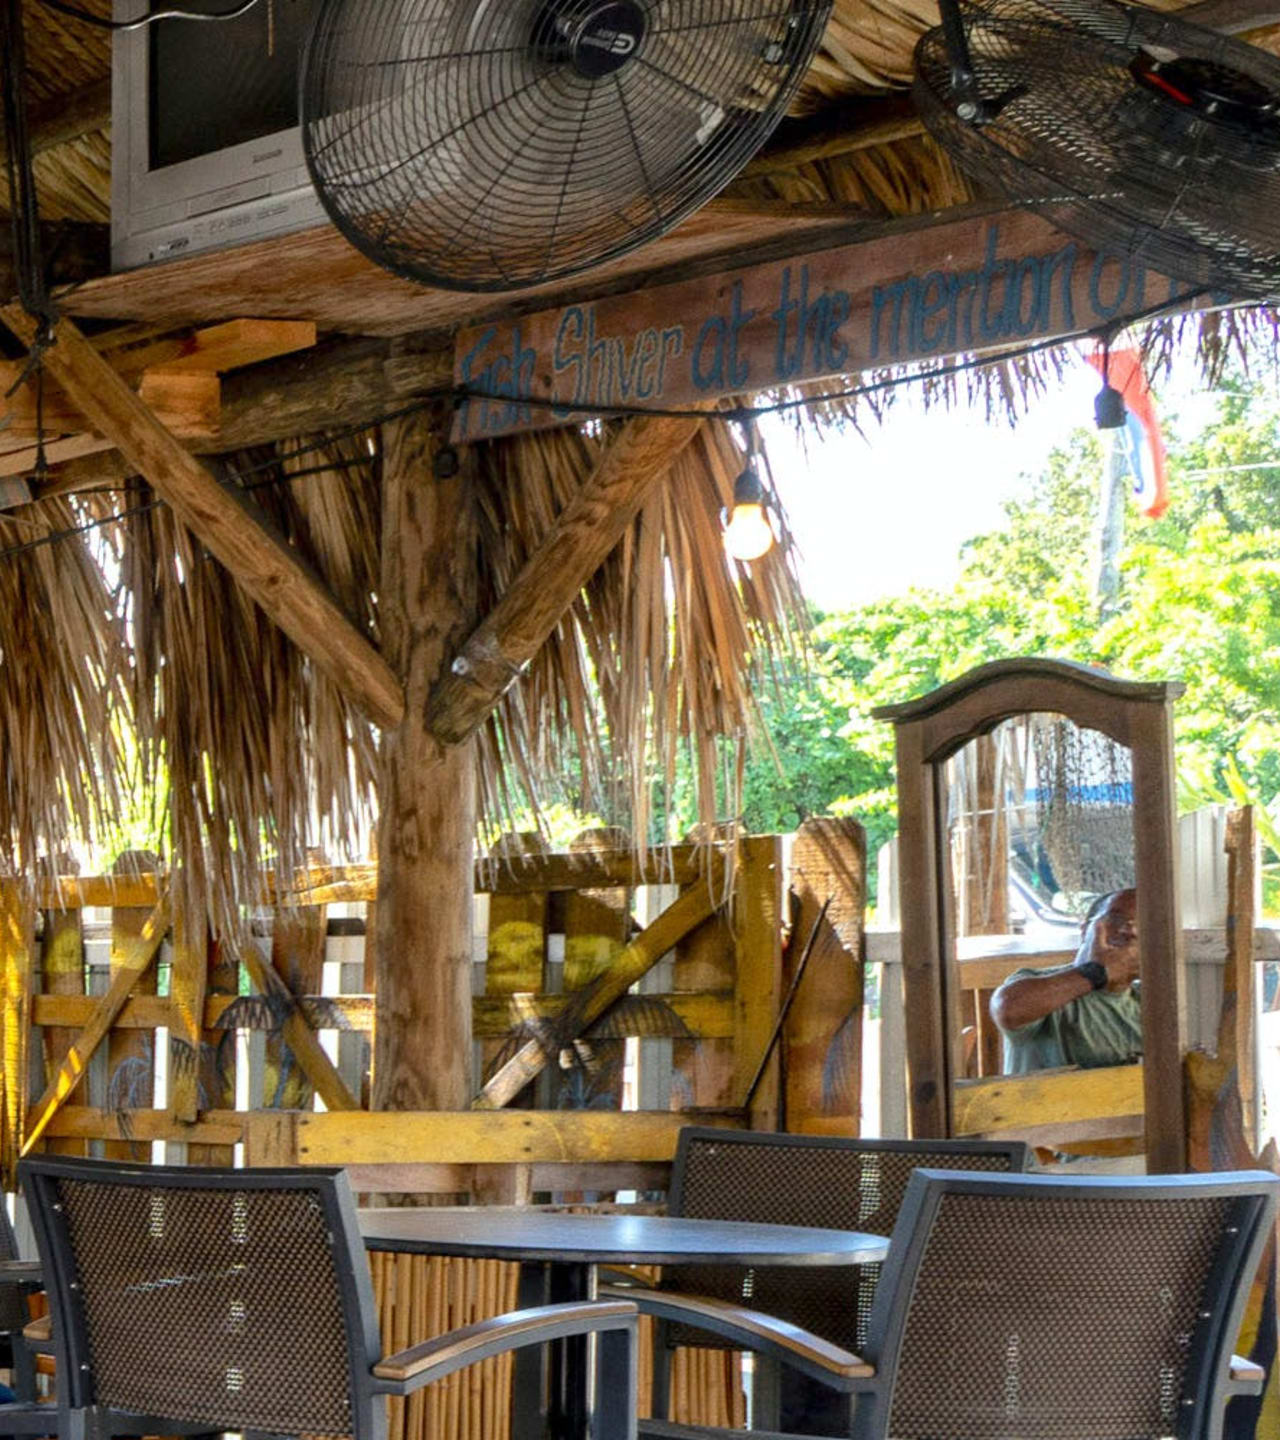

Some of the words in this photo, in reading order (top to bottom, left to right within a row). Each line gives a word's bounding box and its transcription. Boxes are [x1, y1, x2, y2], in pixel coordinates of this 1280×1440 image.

[552, 306, 683, 419] Shiver
[692, 279, 757, 390] at
[772, 264, 850, 380] the
[869, 225, 1078, 360] mention
